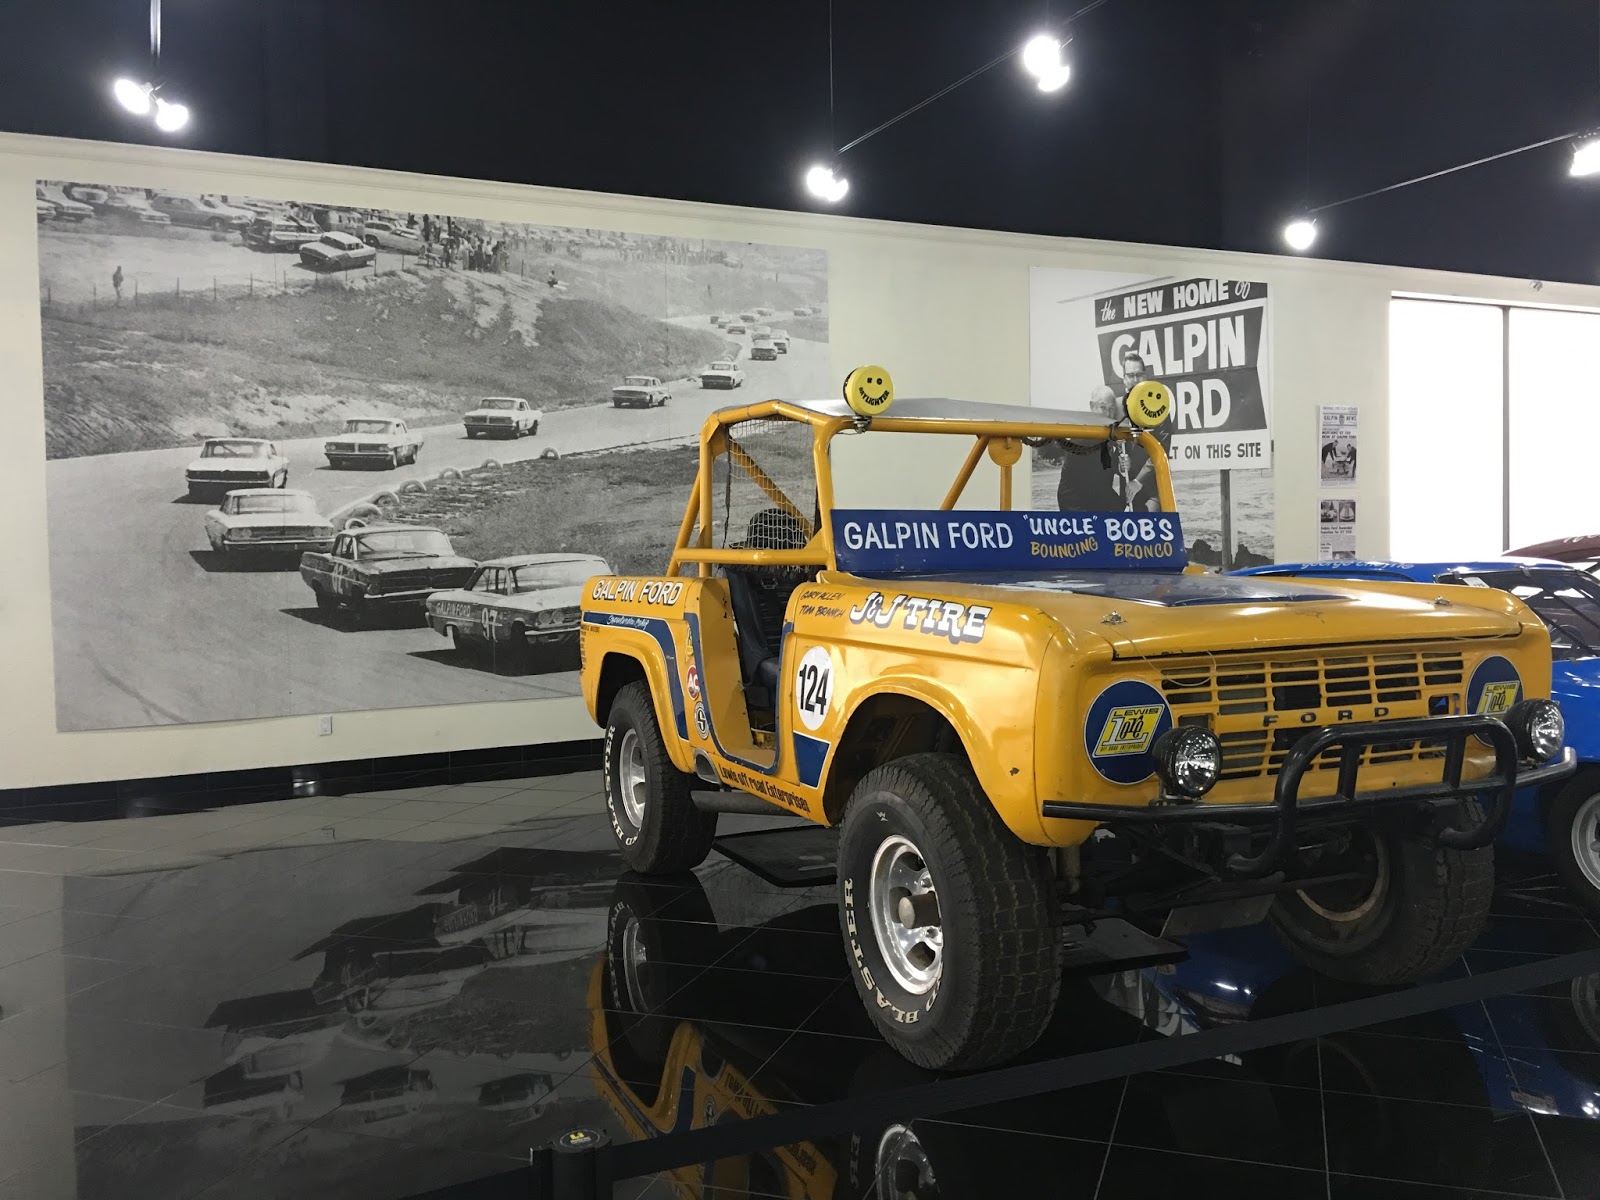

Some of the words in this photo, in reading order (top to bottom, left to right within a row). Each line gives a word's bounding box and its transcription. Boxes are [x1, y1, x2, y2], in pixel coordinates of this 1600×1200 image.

[1101, 299, 1116, 321] the
[1123, 290, 1164, 318] NEW
[1173, 280, 1229, 310] HOME
[1111, 315, 1246, 379] GALPIN
[1185, 445, 1201, 459] ON
[1207, 443, 1231, 459] THIS
[1237, 442, 1261, 458] SITE
[844, 521, 941, 550] GALPIN
[949, 522, 1014, 550] FORD
[1023, 514, 1098, 537] "UNCLE"
[1104, 517, 1175, 542] BOB'S
[1030, 537, 1099, 559] BOUNCING
[1114, 541, 1173, 559] BRONCO
[592, 579, 641, 602] GALPIN
[638, 581, 683, 605] FORD
[800, 590, 821, 601] GARY
[436, 602, 457, 616] GALPIN
[456, 603, 471, 618] FORD
[481, 607, 498, 643] 97
[800, 604, 815, 616] TOM
[850, 591, 908, 629] J&J
[903, 596, 992, 644] TIRE
[799, 664, 830, 716] 124
[1113, 707, 1160, 717] LEWIS
[1263, 707, 1389, 727] FORD
[738, 771, 749, 787] off
[748, 776, 767, 795] road
[764, 780, 811, 813] Enterprises
[844, 877, 920, 1024] BLASTER
